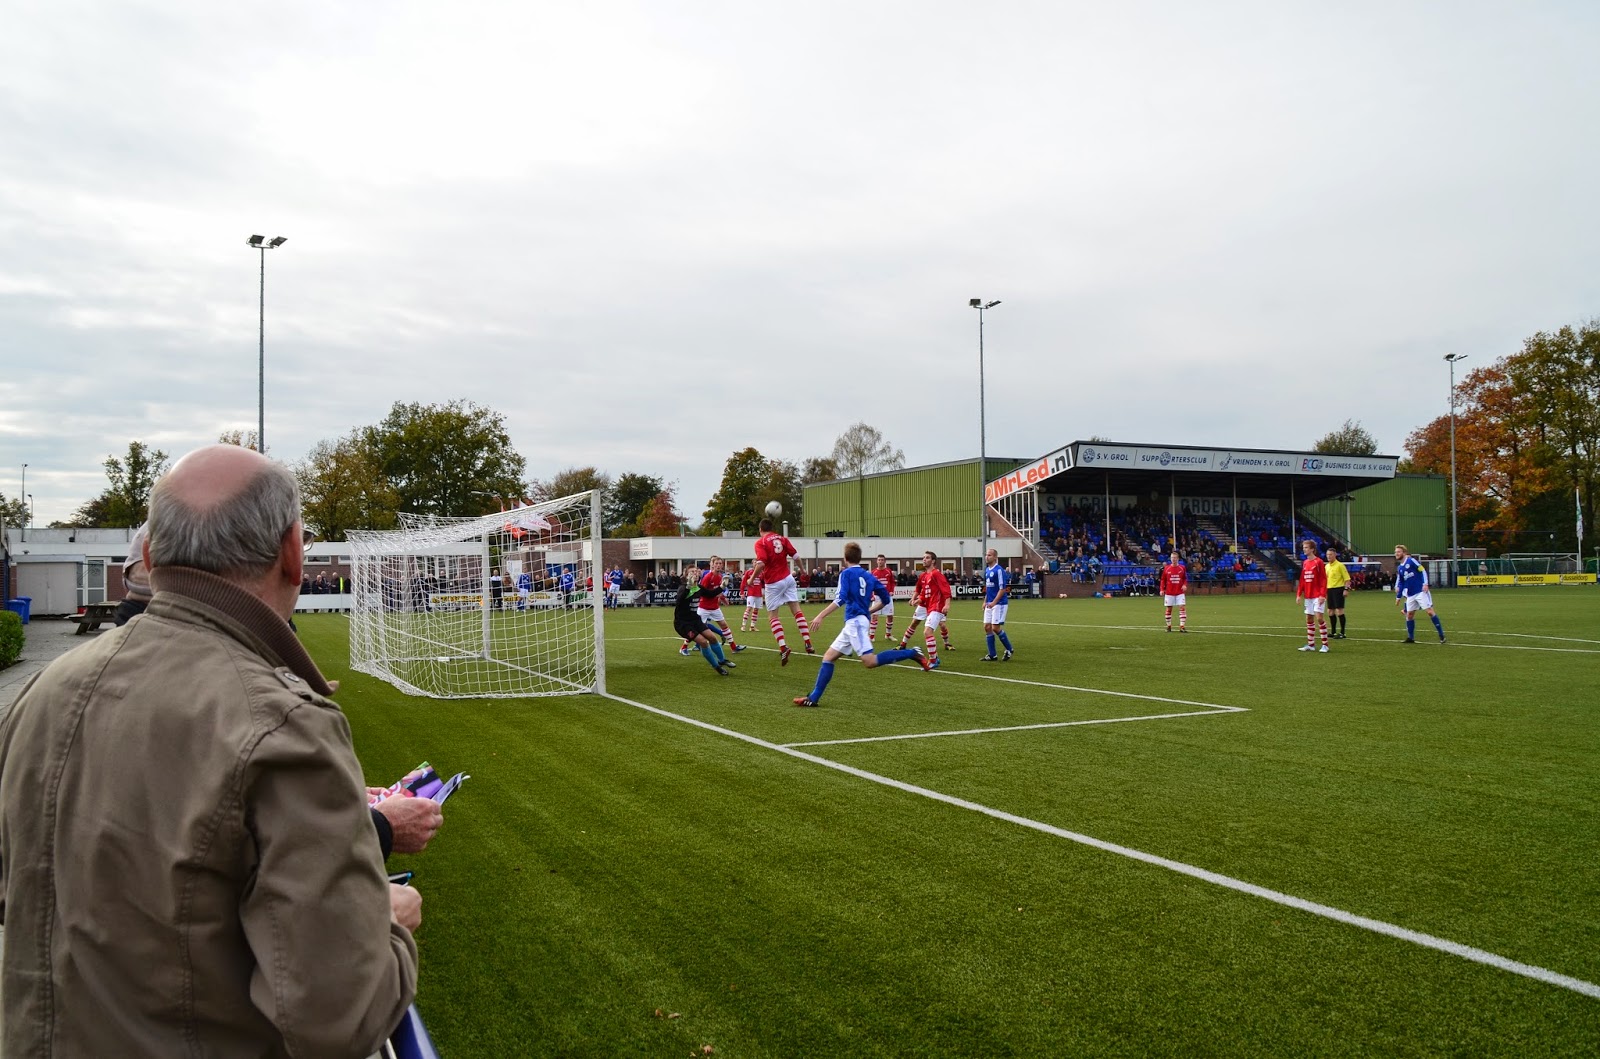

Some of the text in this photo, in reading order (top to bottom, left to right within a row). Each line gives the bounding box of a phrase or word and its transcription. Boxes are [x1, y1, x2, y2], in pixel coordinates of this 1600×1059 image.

[1096, 452, 1129, 461] S.V. GROL
[1232, 458, 1262, 467] VRIENDEN
[1274, 460, 1291, 468] GROL
[1324, 462, 1352, 470] BUSINESS
[1353, 463, 1367, 471] CLUB
[993, 448, 1071, 499] MrLed.nl
[858, 576, 867, 597] 9
[654, 591, 668, 599] HET
